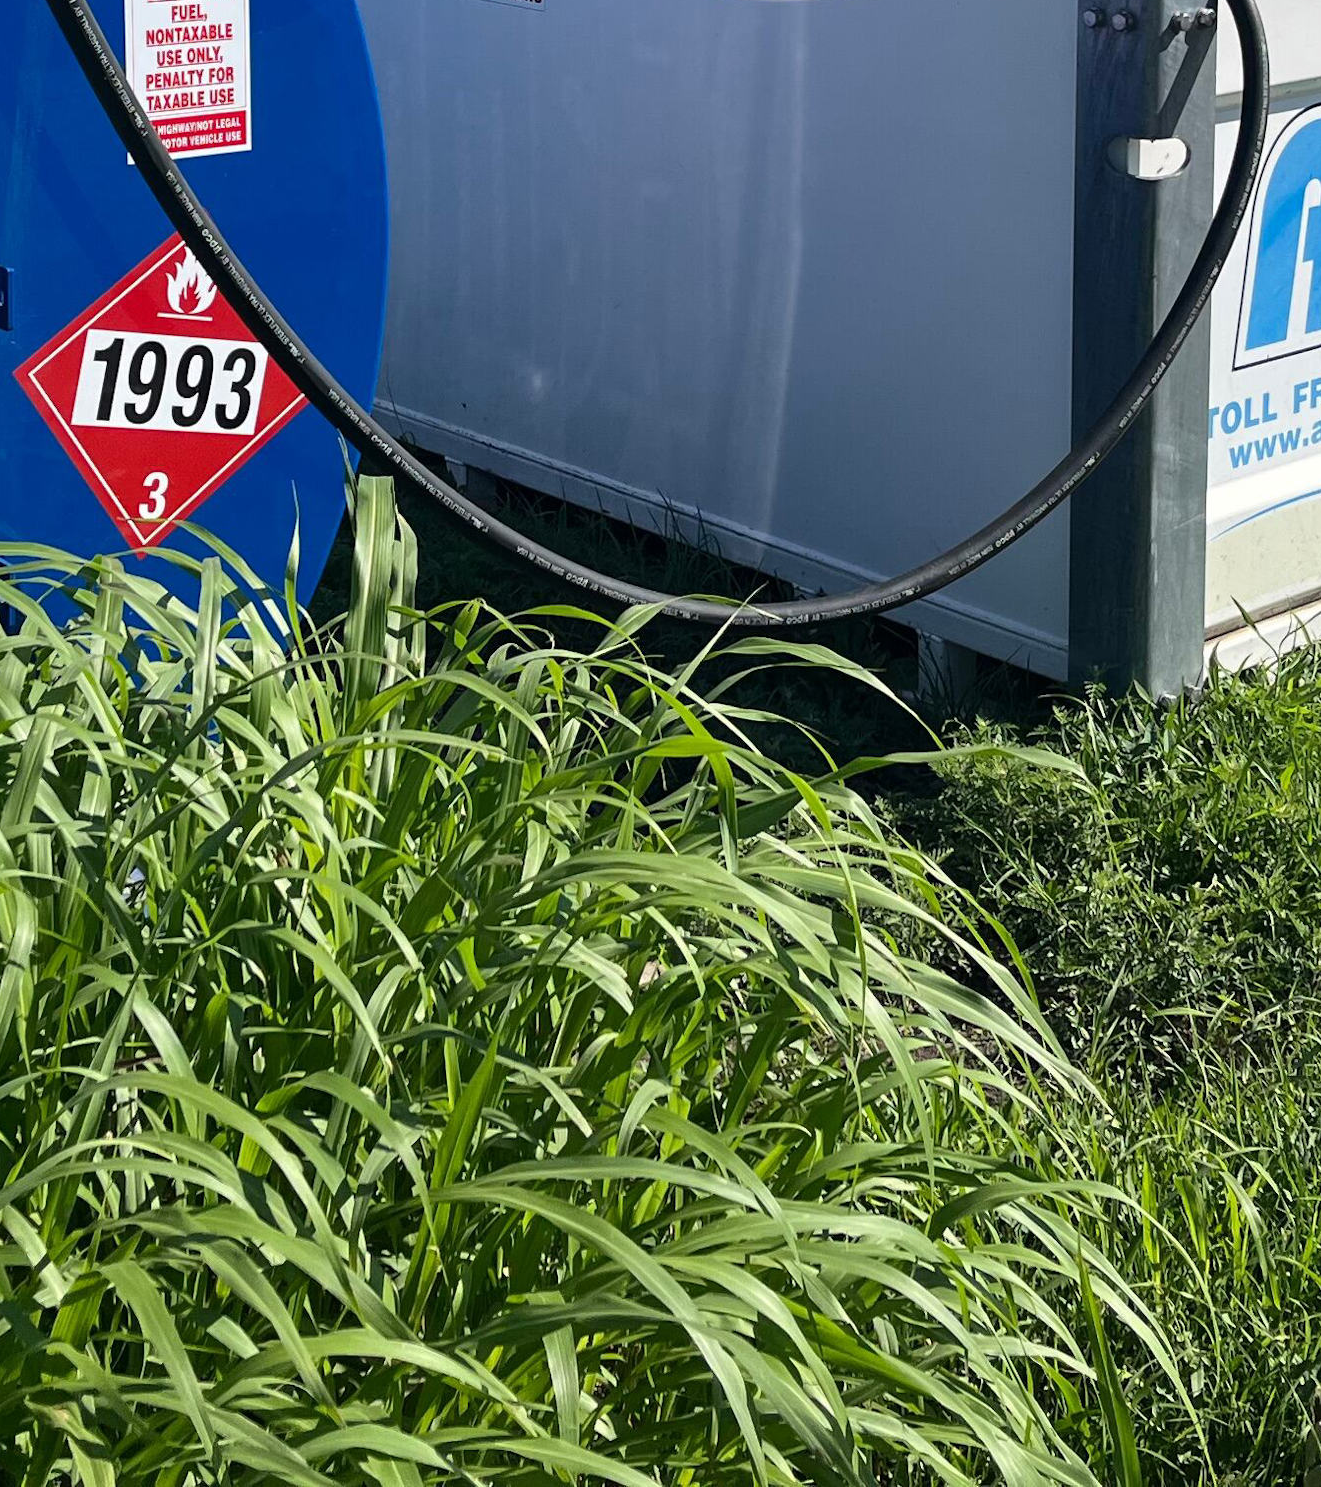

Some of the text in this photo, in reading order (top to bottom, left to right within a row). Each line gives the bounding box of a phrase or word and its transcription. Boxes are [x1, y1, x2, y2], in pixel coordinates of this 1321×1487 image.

[72, 4, 84, 17] BY
[171, 4, 208, 21] FUEL,
[146, 23, 233, 45] NONTAXABLE
[97, 51, 116, 76] ULTRA
[156, 46, 224, 67] USE ONLY,
[146, 66, 234, 90] PENALTY FOR
[146, 88, 235, 112] TAXABLE USE
[215, 117, 241, 129] LEGAL
[189, 133, 224, 146] VEHICLE
[225, 131, 242, 142] USE
[91, 336, 258, 431] 1993
[1208, 392, 1277, 439] TOLL
[140, 470, 169, 520] 3
